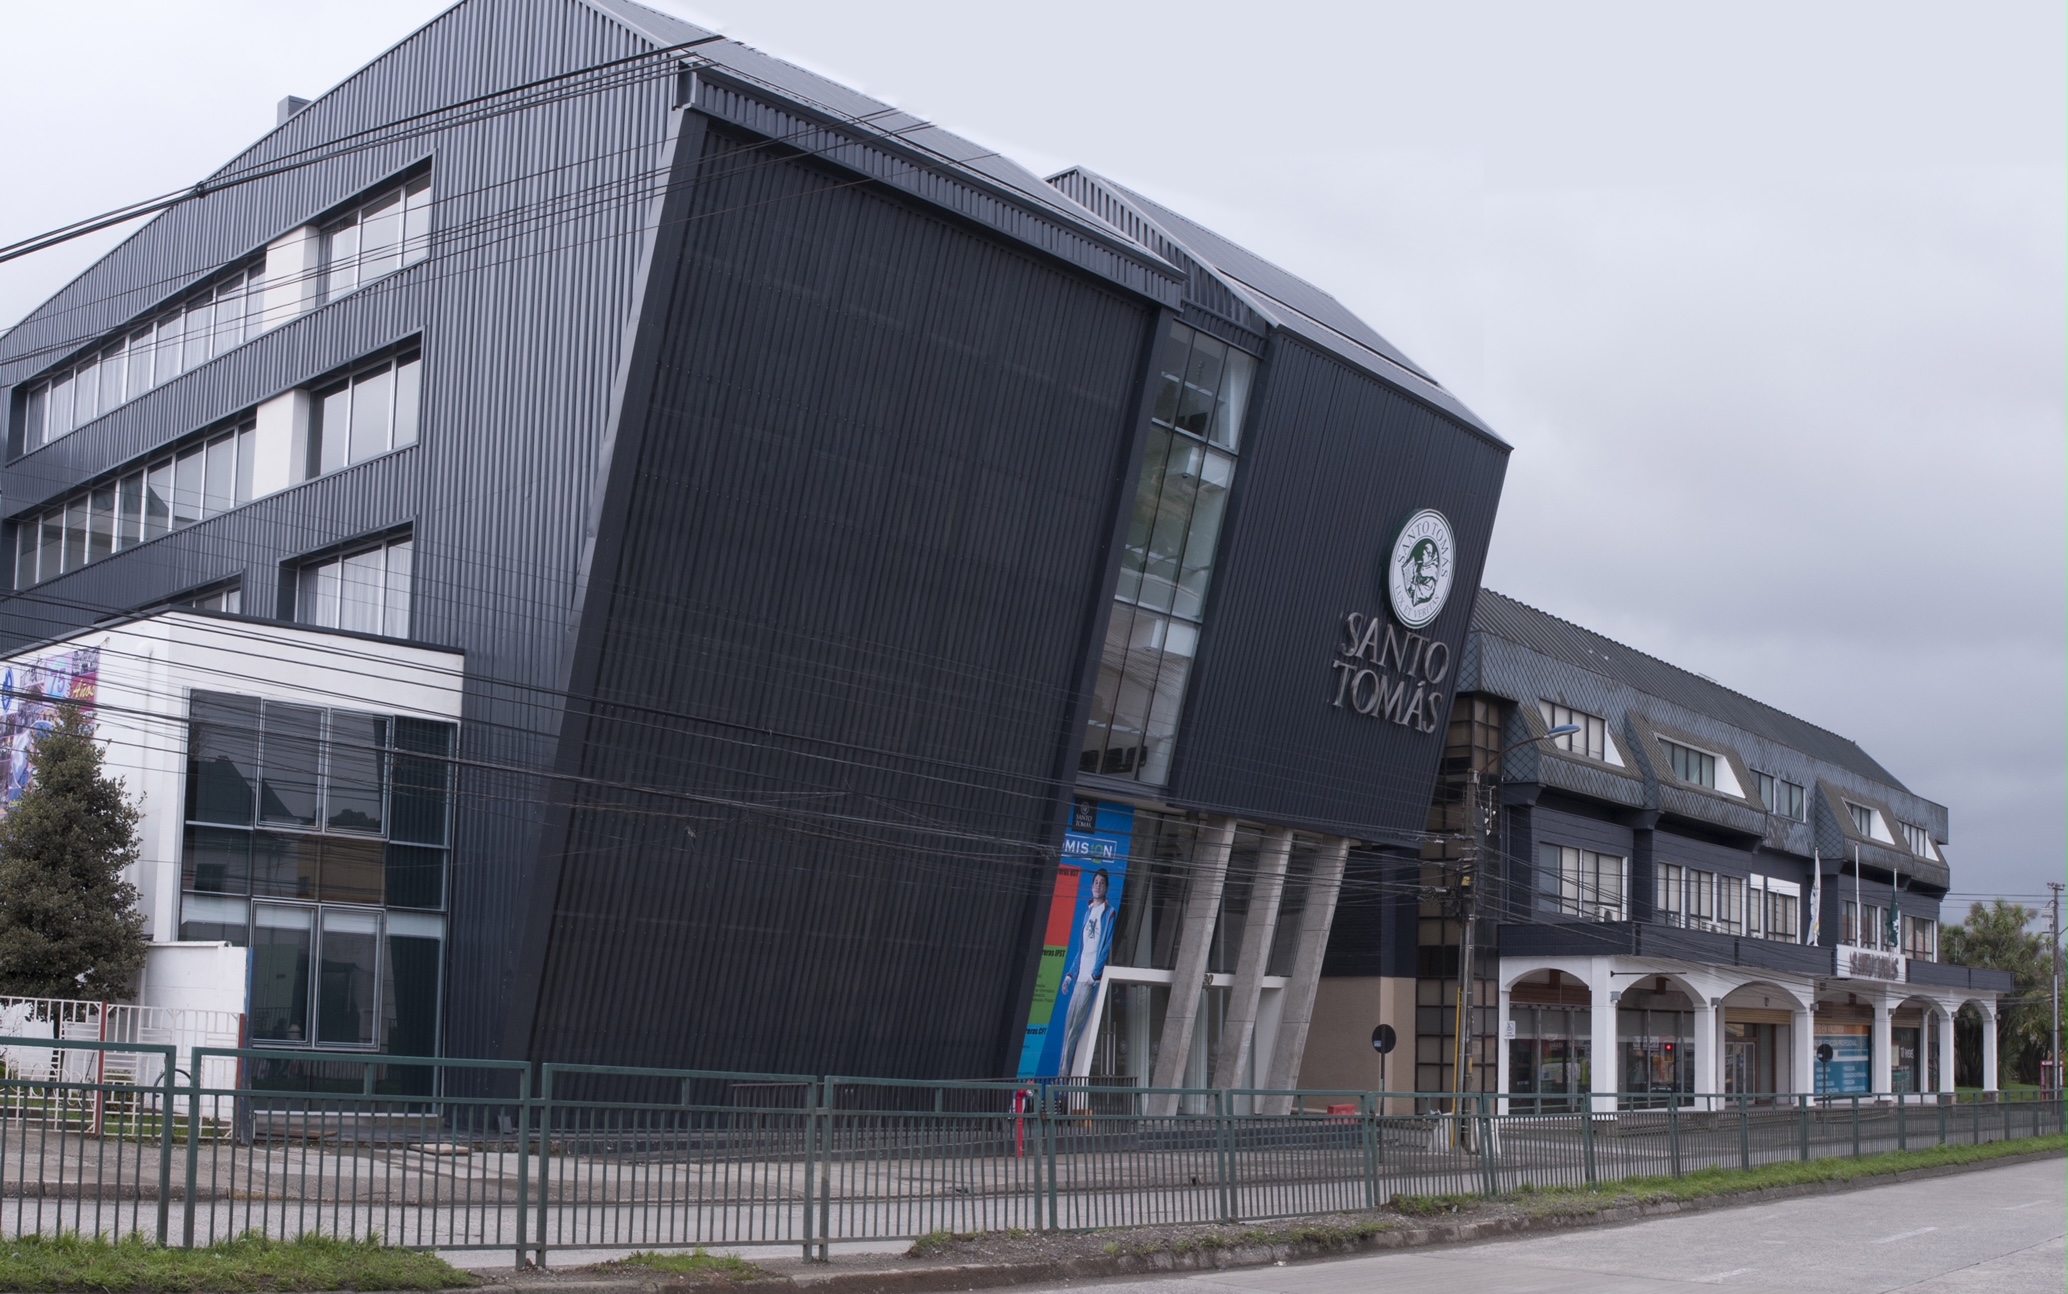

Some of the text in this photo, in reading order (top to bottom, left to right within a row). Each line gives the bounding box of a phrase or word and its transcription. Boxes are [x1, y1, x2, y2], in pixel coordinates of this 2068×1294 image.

[1397, 520, 1430, 564] SANTO
[1395, 585, 1440, 619] LUX ET VERITAS
[1341, 612, 1450, 684] SANTO
[1332, 659, 1443, 734] TOMÁS
[1075, 813, 1093, 822] SANTO
